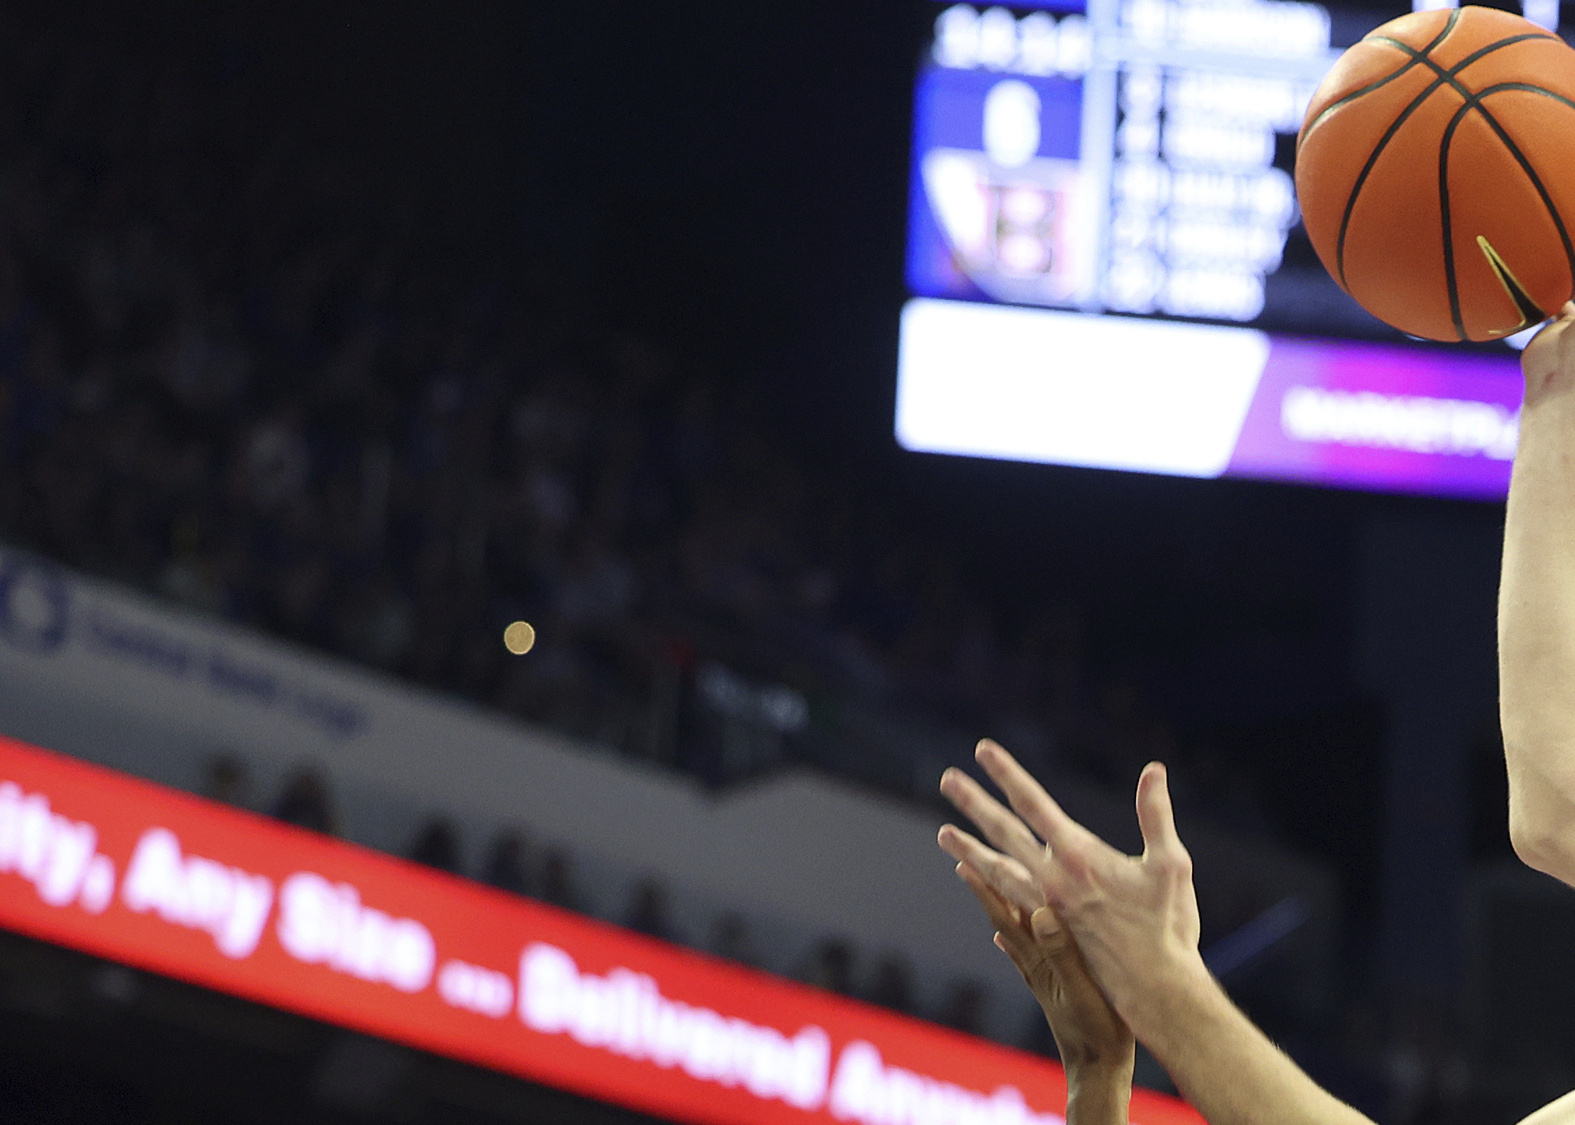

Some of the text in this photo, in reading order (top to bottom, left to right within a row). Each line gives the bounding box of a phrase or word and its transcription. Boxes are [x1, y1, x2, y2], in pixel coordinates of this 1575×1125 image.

[124, 828, 273, 958] Any
[278, 871, 435, 991] Size
[518, 943, 829, 1112] Delivered
